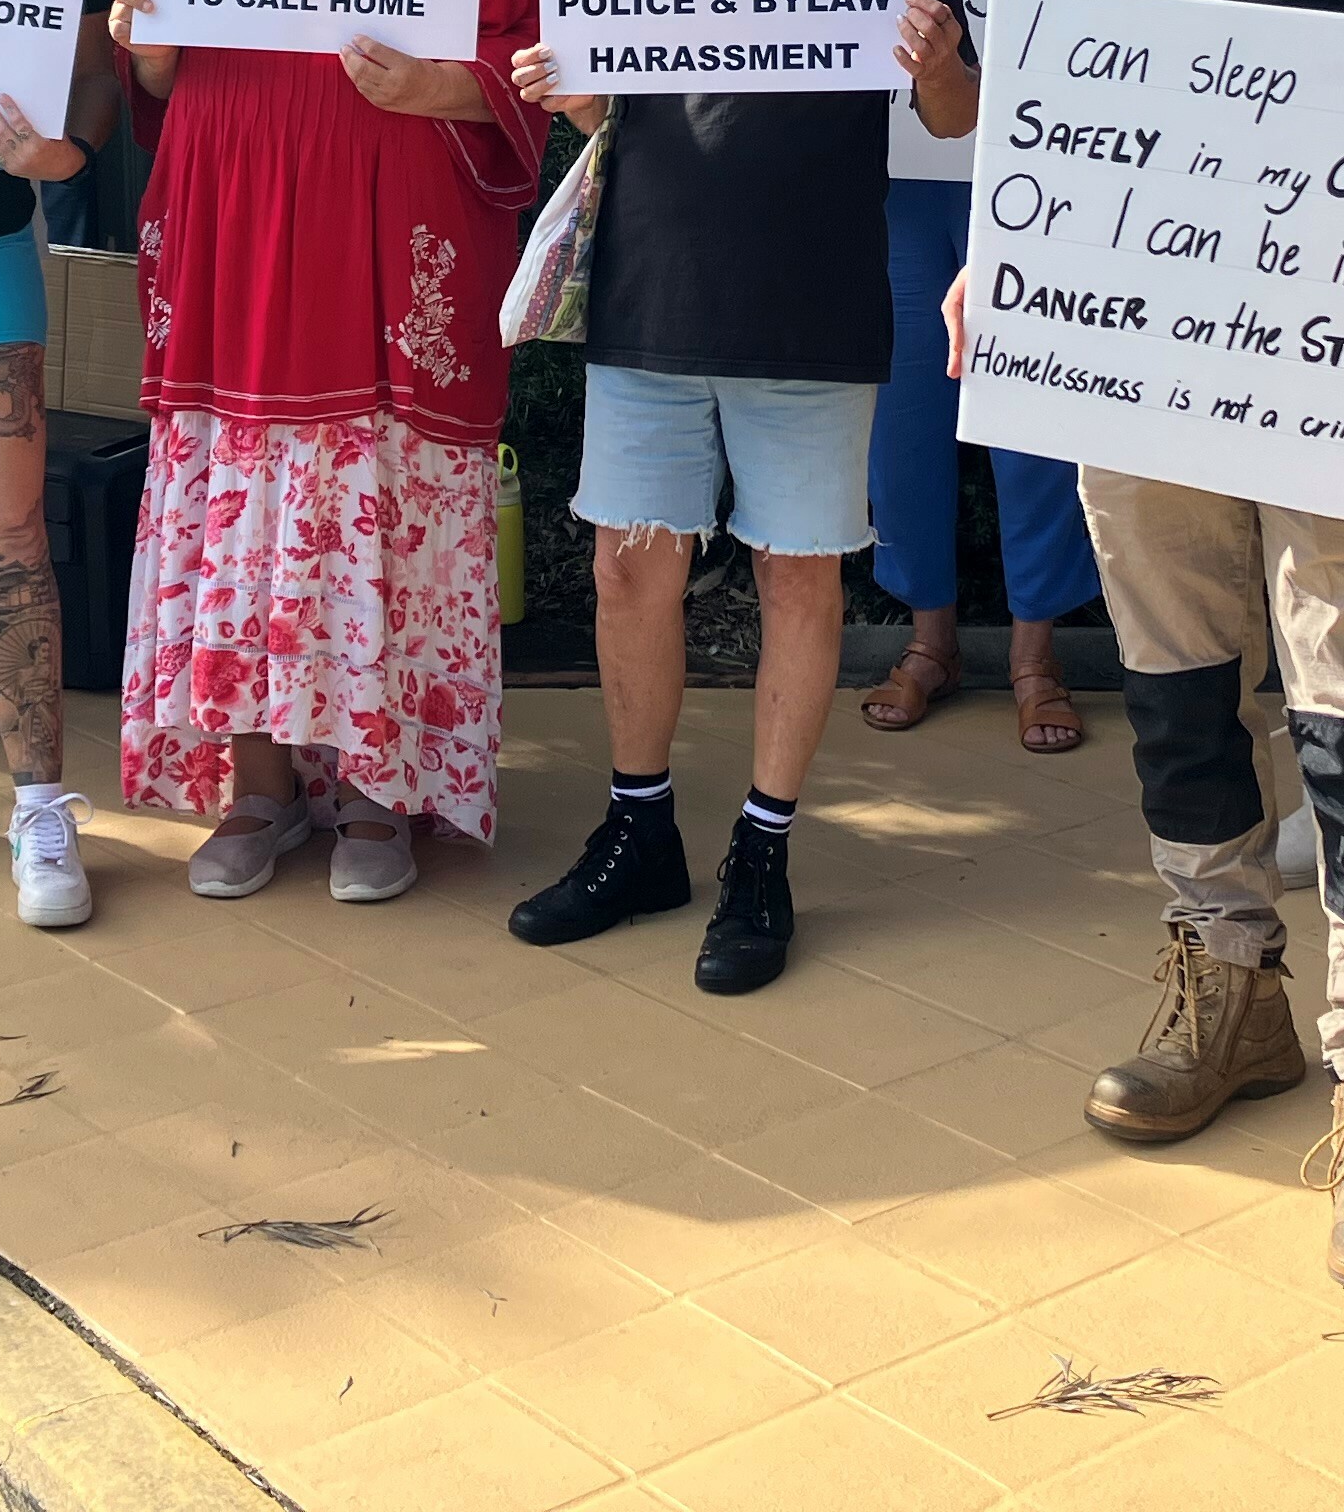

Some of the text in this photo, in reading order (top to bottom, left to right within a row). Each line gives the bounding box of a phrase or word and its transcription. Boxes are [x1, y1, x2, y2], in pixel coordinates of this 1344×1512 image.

[589, 42, 860, 73] HARASSMENT
[1018, 0, 1297, 125] I can sleep
[1009, 99, 1162, 169] SAFELY
[1188, 142, 1223, 179] in
[1257, 165, 1312, 216] my
[991, 173, 1072, 236] Or
[1111, 187, 1134, 249] I
[1146, 218, 1221, 263] can
[1256, 219, 1300, 276] be
[991, 262, 1148, 330] DANGER
[1171, 315, 1216, 345] on
[1225, 301, 1282, 356] the
[970, 333, 1144, 404] Homelessness
[1167, 379, 1190, 411] is
[1210, 393, 1254, 424] not
[1260, 409, 1278, 429] a
